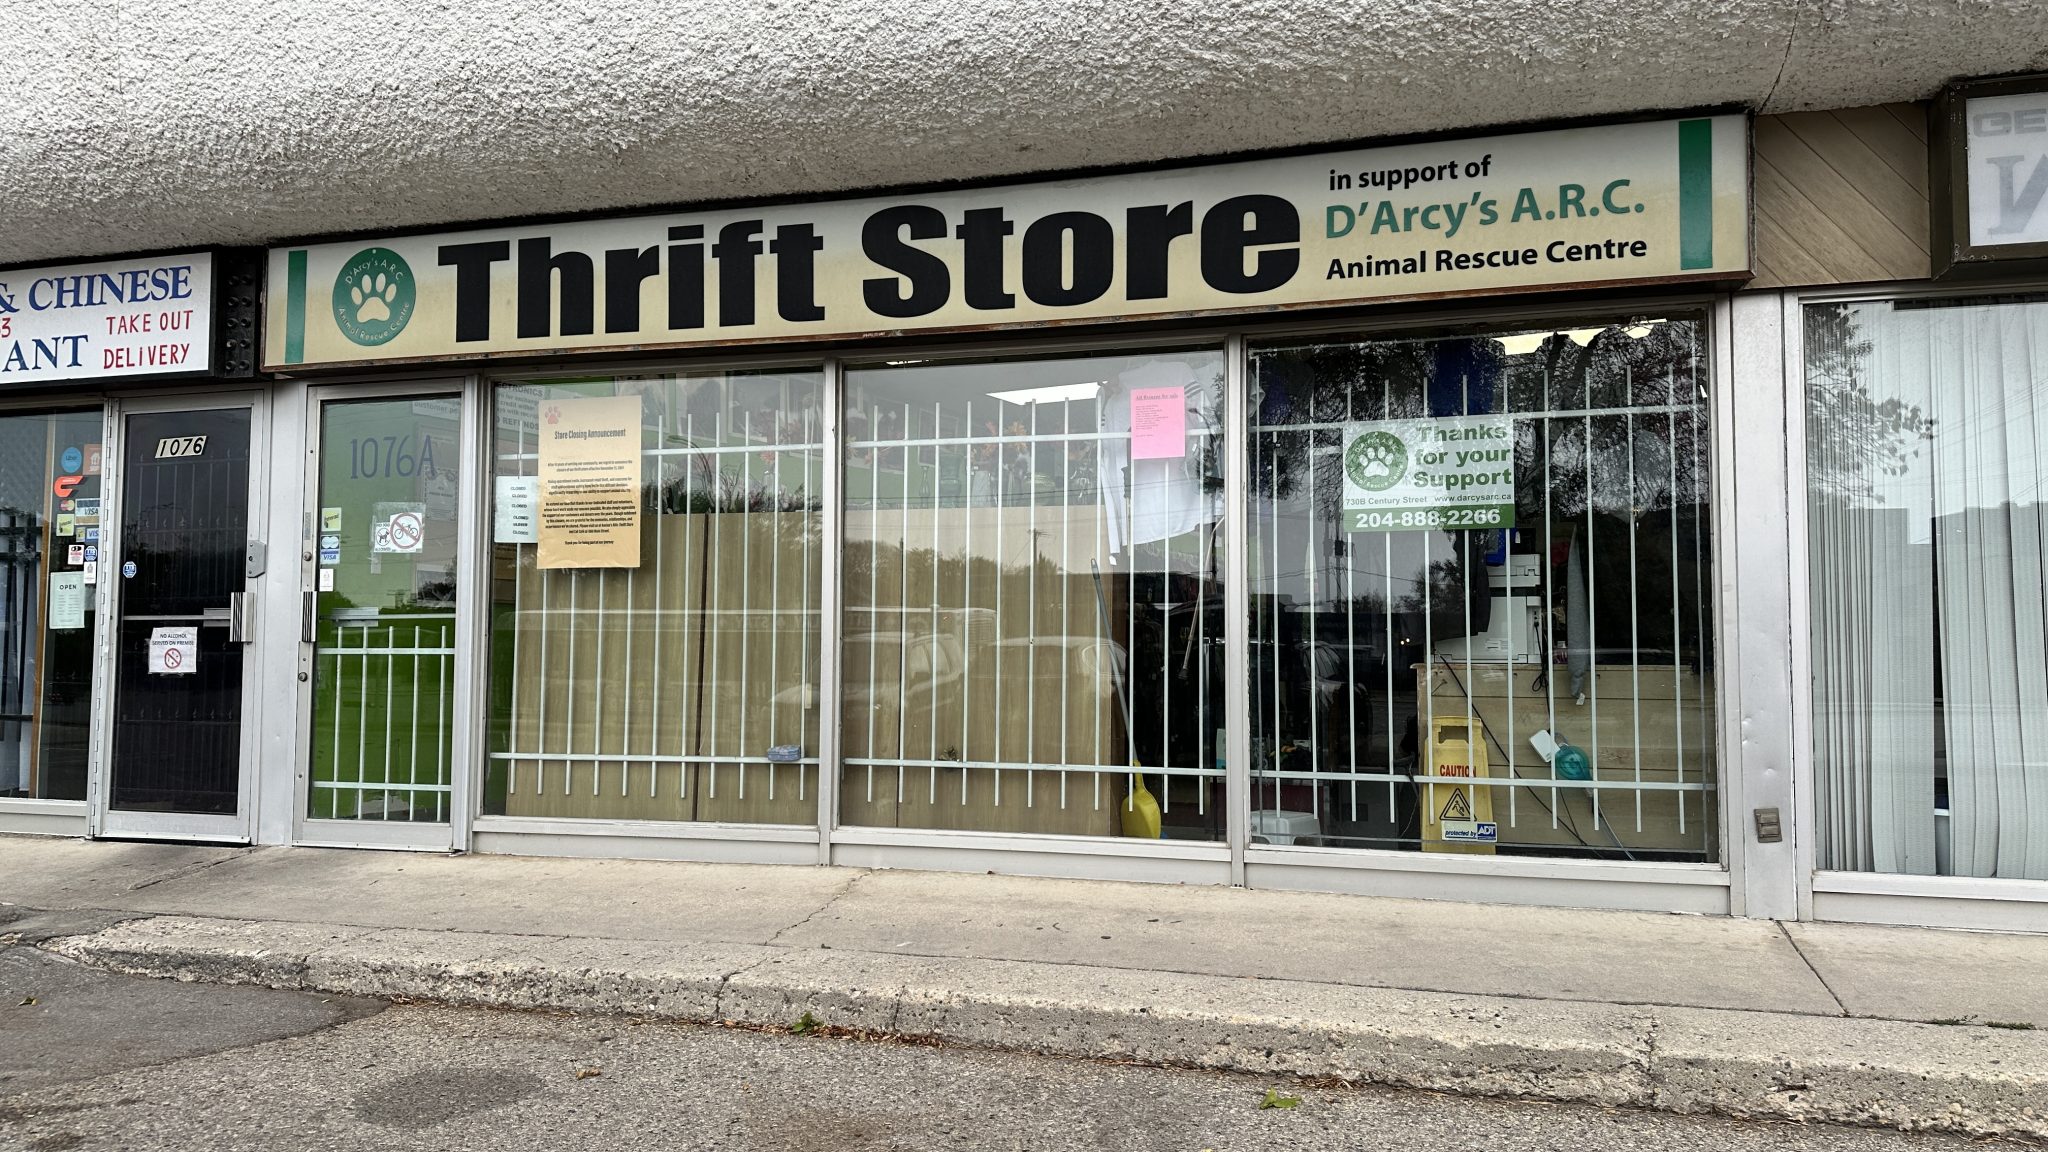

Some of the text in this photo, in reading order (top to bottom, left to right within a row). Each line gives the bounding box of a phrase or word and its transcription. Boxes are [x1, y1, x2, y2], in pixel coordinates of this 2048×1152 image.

[1329, 154, 1492, 191] in support of
[1326, 178, 1645, 239] D'Arcy's A.R.C.
[437, 193, 1301, 343] Thrift Store
[1326, 238, 1647, 280] Animal Rescue Centre
[345, 258, 378, 285] D'Arcy's
[28, 265, 192, 311] CHINESE
[106, 310, 193, 335] TAKE OUT
[338, 303, 410, 341] Animal Rescue Centre
[554, 428, 626, 441] Store Closing Announcement
[1416, 424, 1507, 443] Thanks
[160, 437, 204, 457] 1076
[350, 434, 437, 480] 1076A
[1415, 448, 1511, 468] for your
[1413, 467, 1512, 491] Support
[1368, 497, 1400, 506] Century
[1402, 494, 1427, 504] Street
[1434, 492, 1512, 504] www.darcysarc.ca
[84, 508, 99, 516] VISA
[1355, 508, 1500, 529] 204-888-2266
[89, 530, 99, 538] VIS
[1445, 825, 1495, 838] protected by ADT
